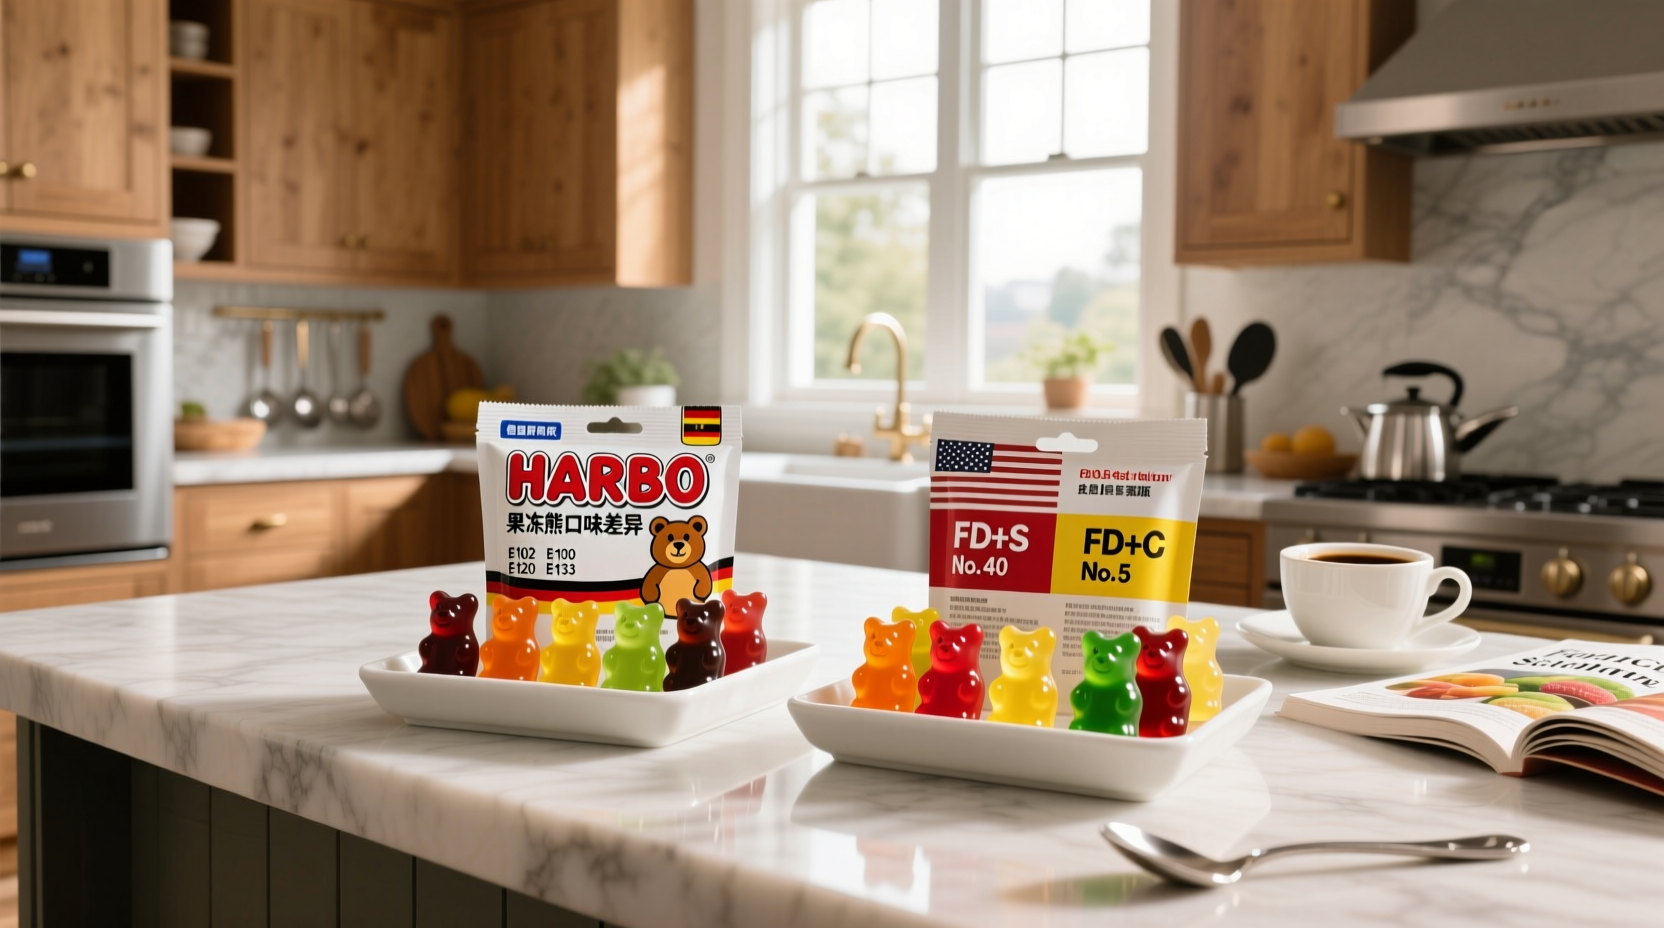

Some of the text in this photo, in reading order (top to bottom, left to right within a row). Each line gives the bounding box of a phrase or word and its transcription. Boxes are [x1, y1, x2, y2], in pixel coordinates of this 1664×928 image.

[507, 451, 709, 507] HARBO
[506, 511, 643, 536] 果冻熊口味差异
[953, 520, 1029, 552] FD+S
[1083, 527, 1166, 559] FD+C
[508, 547, 576, 561] E102 E100
[951, 554, 1009, 576] No.40
[508, 562, 576, 576] E120 E133
[1080, 561, 1131, 583] No.5
